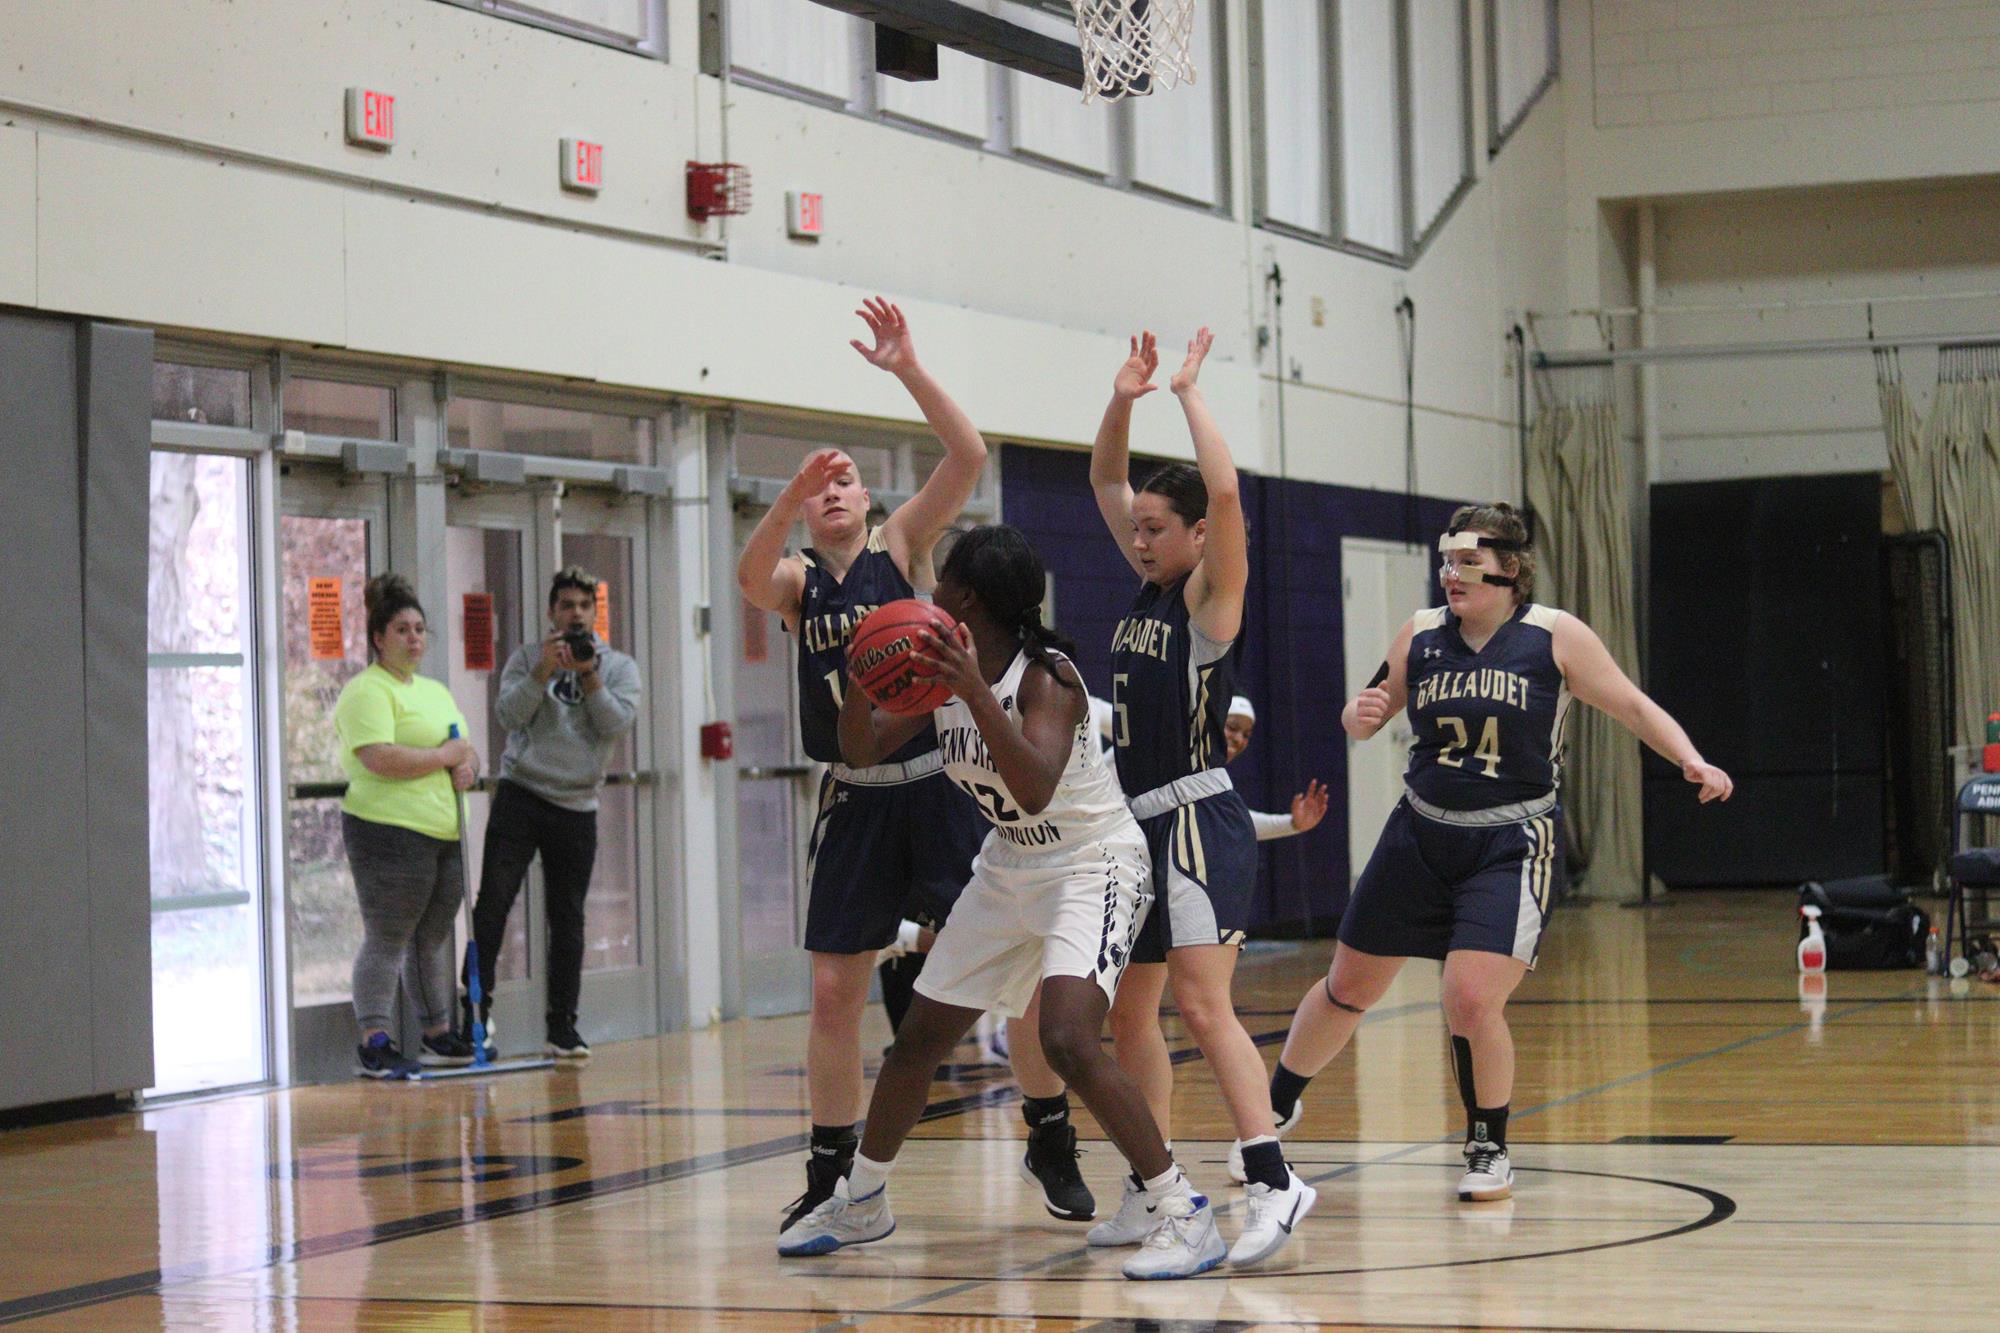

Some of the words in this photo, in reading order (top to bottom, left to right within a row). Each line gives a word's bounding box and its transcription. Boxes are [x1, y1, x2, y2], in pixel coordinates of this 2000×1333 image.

[364, 90, 394, 141] EXIT
[576, 140, 603, 185] EXIT
[800, 191, 823, 233] EXIT
[854, 636, 914, 679] Wilson
[1113, 673, 1131, 748] 5
[1416, 668, 1529, 712] GALLAUDET
[1436, 716, 1502, 779] 24
[960, 779, 1020, 822] 12
